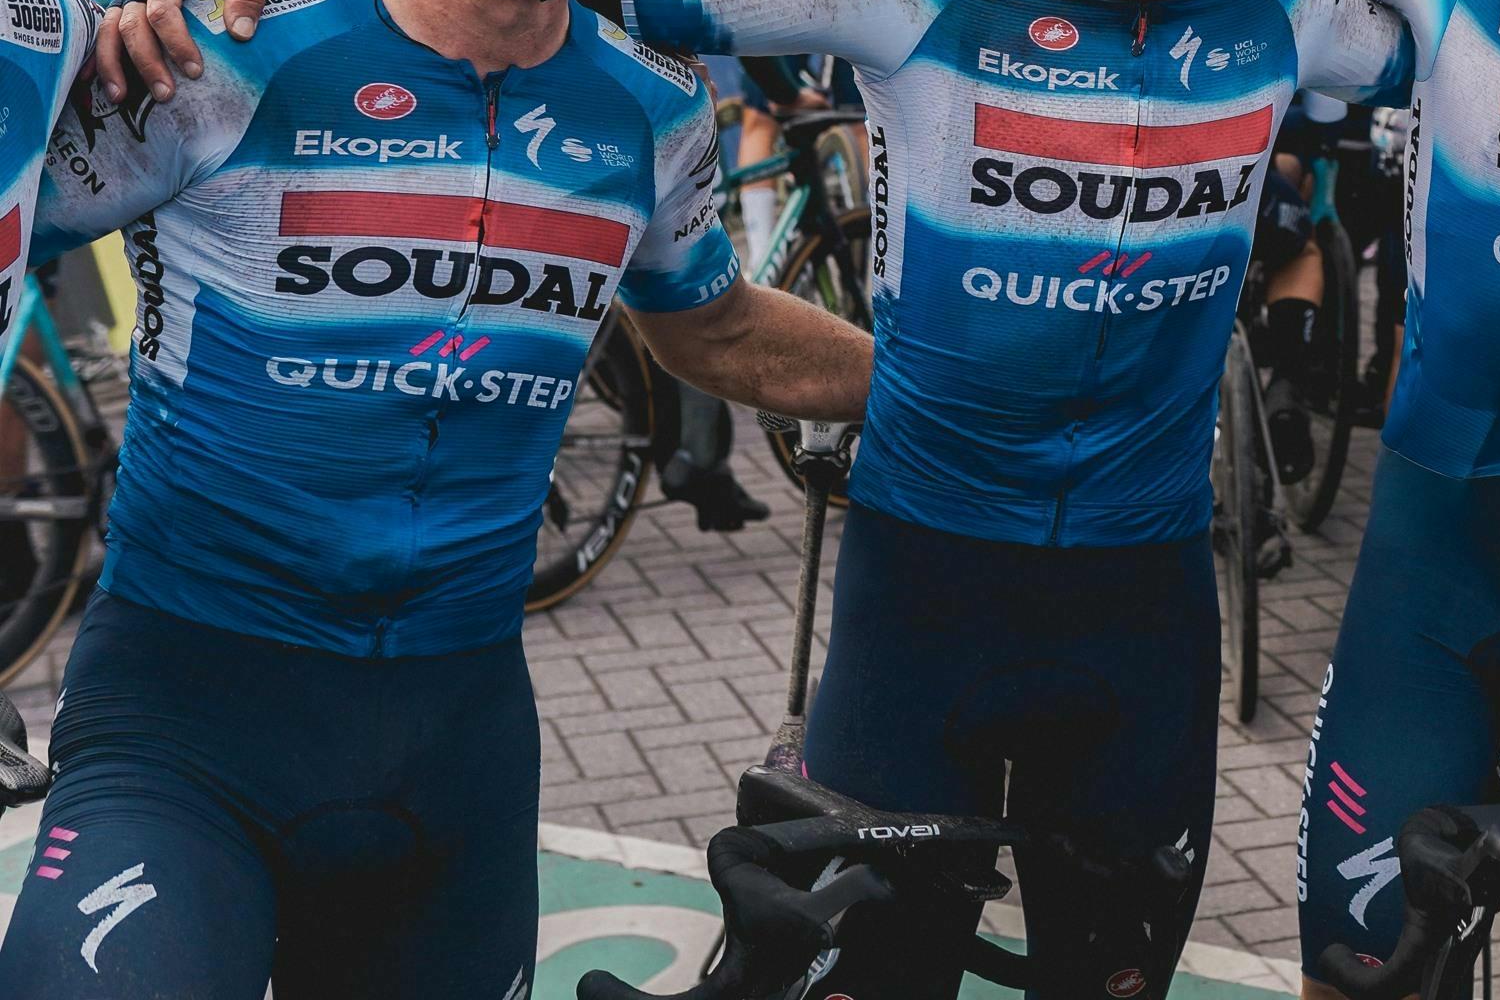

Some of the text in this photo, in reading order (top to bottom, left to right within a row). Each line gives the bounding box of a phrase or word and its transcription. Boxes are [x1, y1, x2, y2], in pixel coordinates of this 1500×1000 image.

[8, 3, 62, 34] JOGGER
[1234, 39, 1254, 51] UCI
[1235, 42, 1268, 59] WORLD
[978, 47, 1120, 91] Ekopak
[294, 130, 463, 163] Ekopak
[871, 125, 889, 279] SOUDAL
[970, 156, 1260, 225] SOUDAL
[275, 245, 610, 322] SOUDAL
[857, 823, 941, 841] roval
